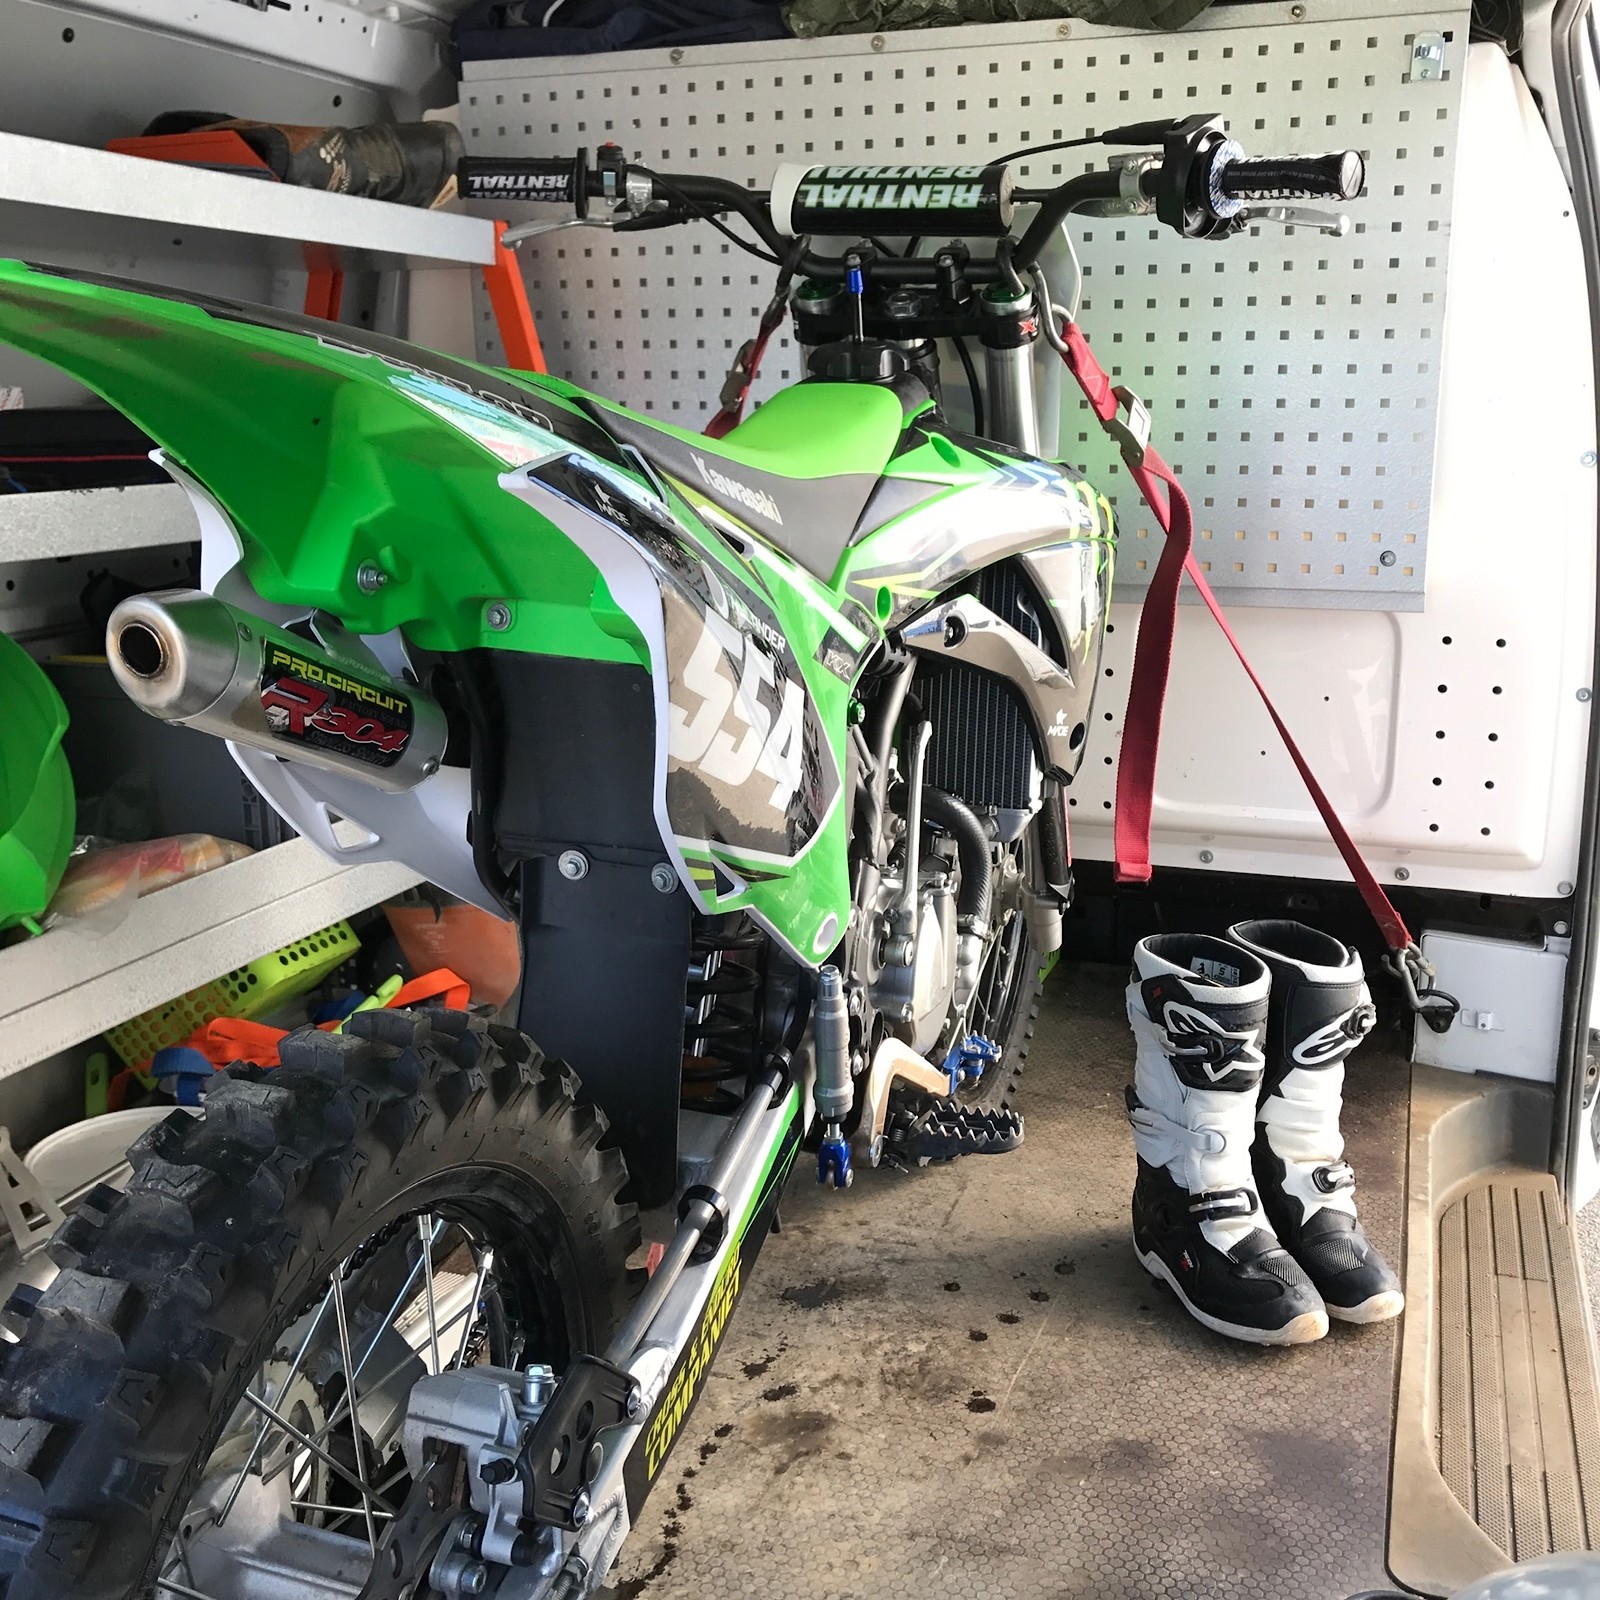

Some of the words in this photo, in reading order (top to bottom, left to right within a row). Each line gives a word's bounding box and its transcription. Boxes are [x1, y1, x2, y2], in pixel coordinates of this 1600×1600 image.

[468, 174, 570, 190] RENTHAL
[800, 184, 984, 209] RENTHAL
[689, 452, 783, 526] Kawasaki
[668, 604, 806, 812] 554
[648, 1258, 743, 1481] COMPANIET
